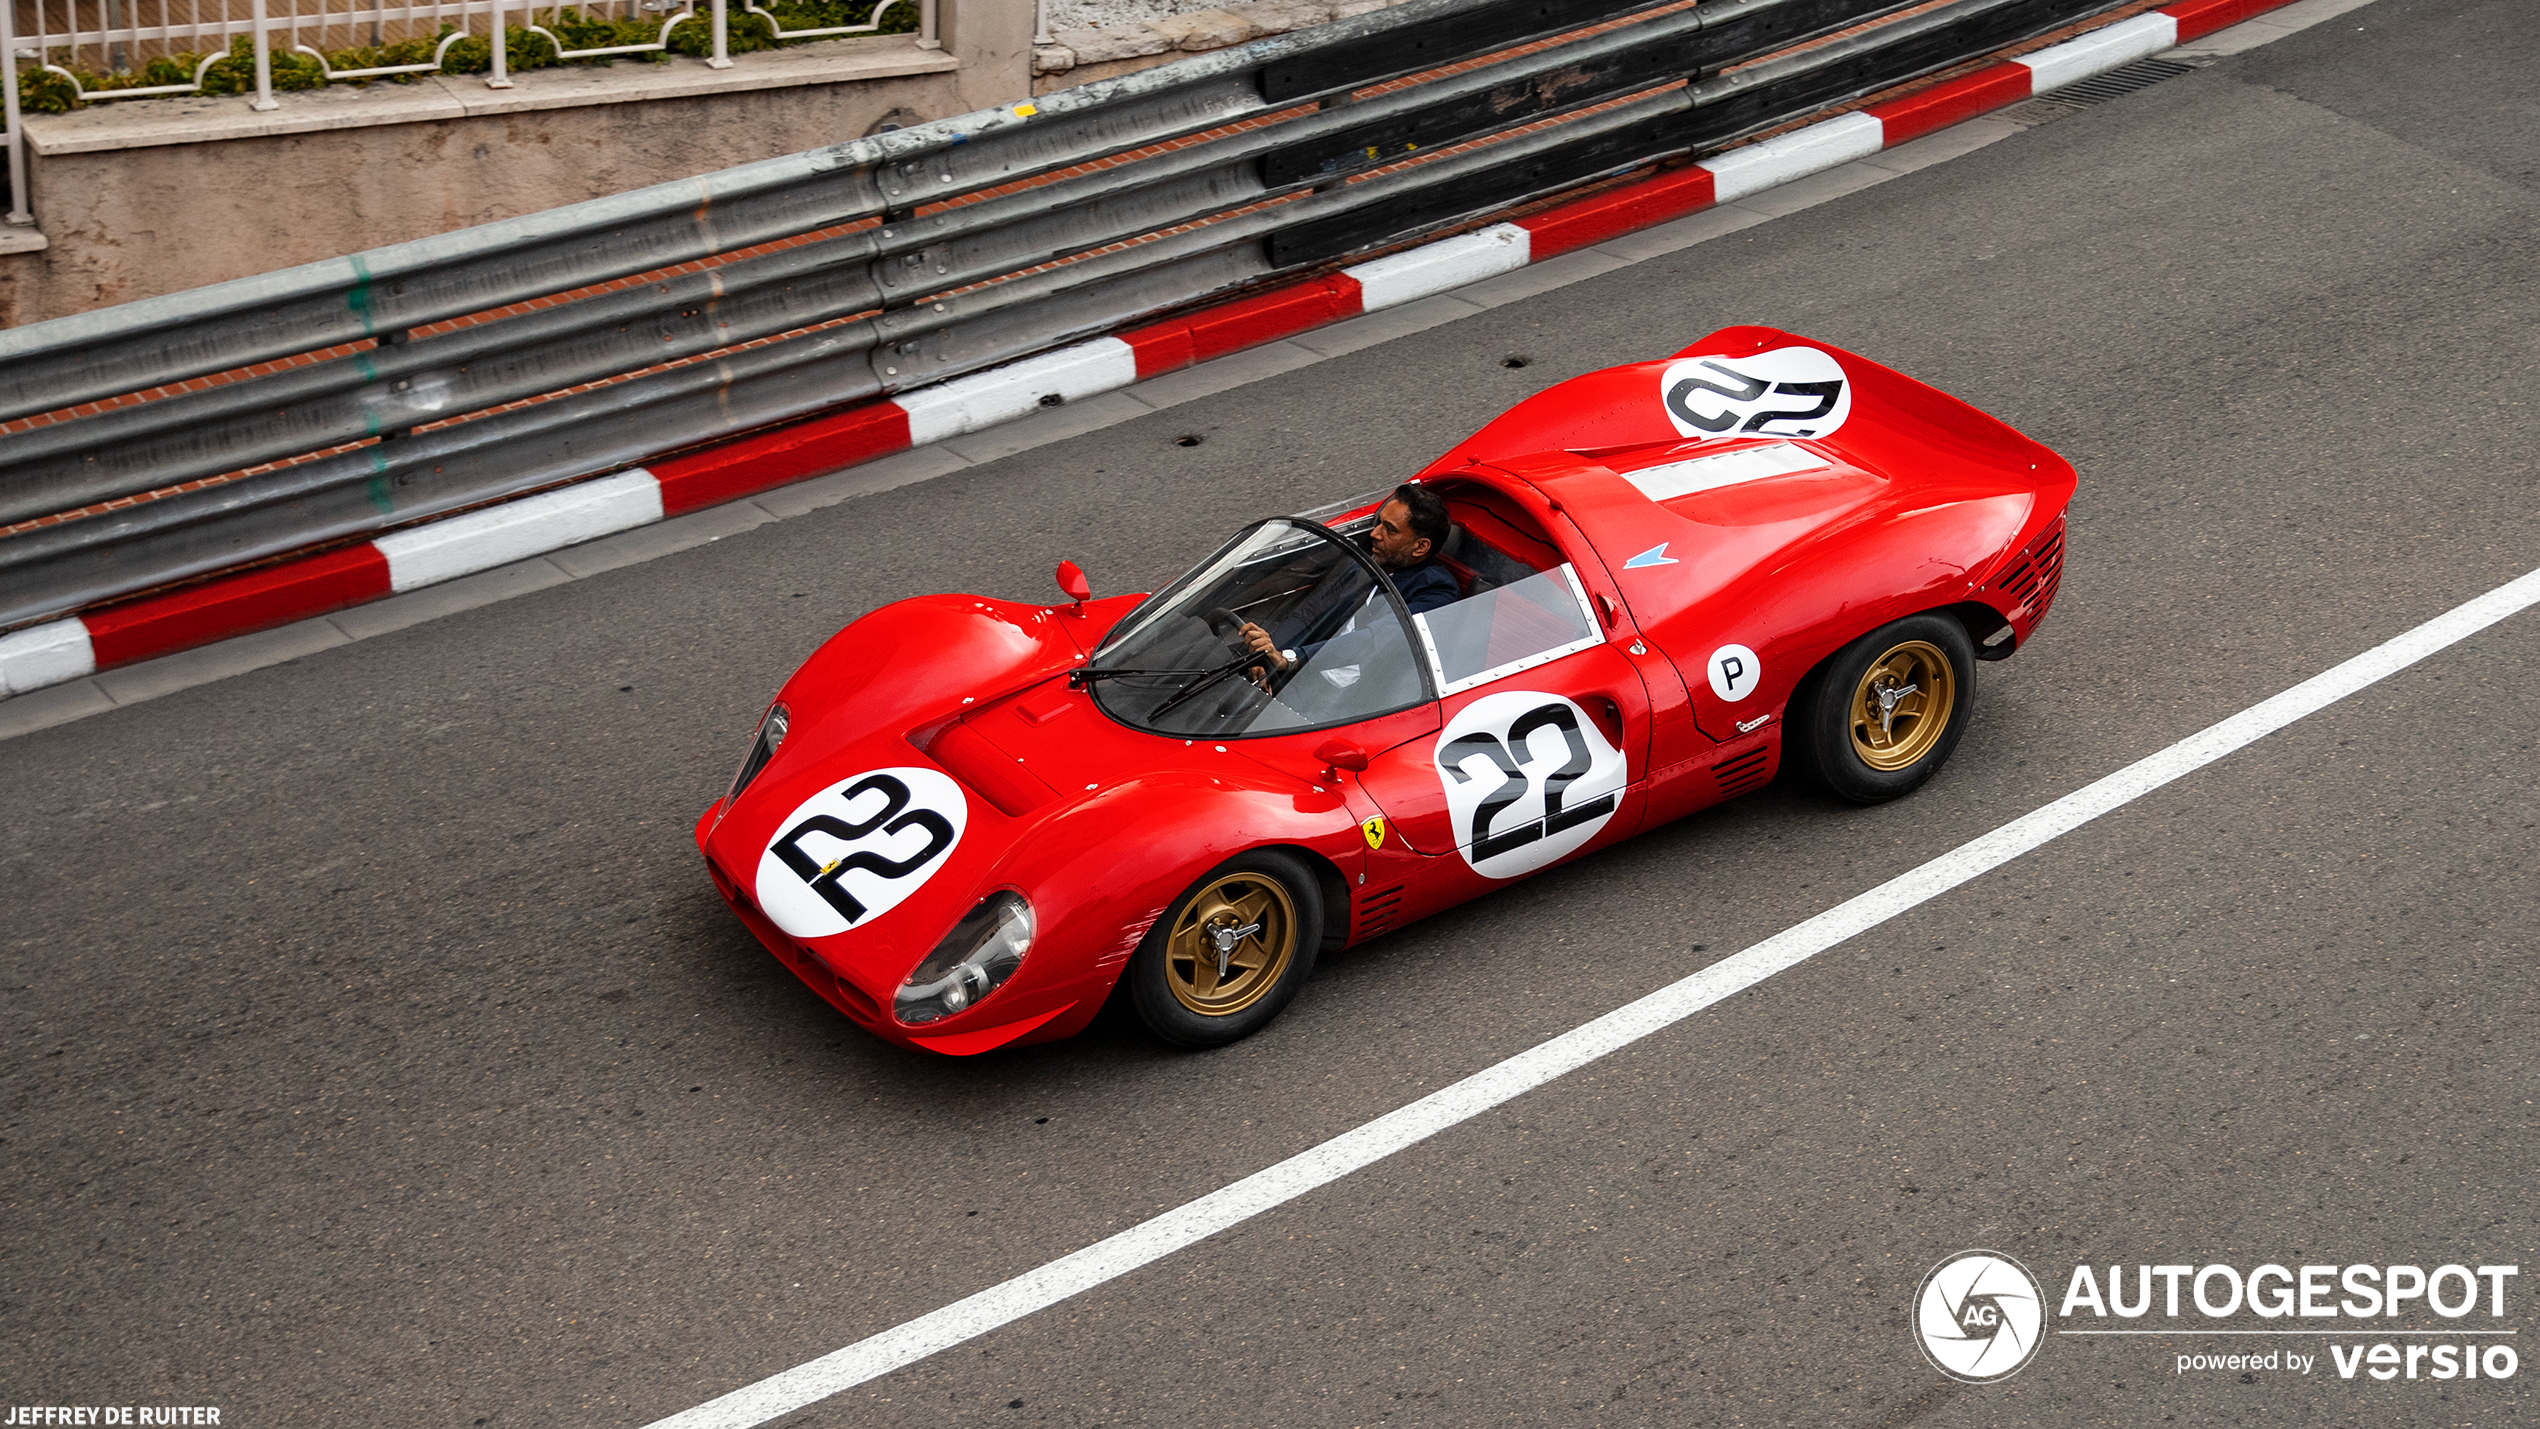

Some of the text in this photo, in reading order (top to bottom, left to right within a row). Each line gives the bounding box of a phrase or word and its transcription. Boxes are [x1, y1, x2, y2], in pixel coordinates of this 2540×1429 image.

[1667, 360, 1844, 438] 22
[1720, 656, 1744, 691] P
[1438, 703, 1616, 865] 22
[769, 773, 955, 925] 22
